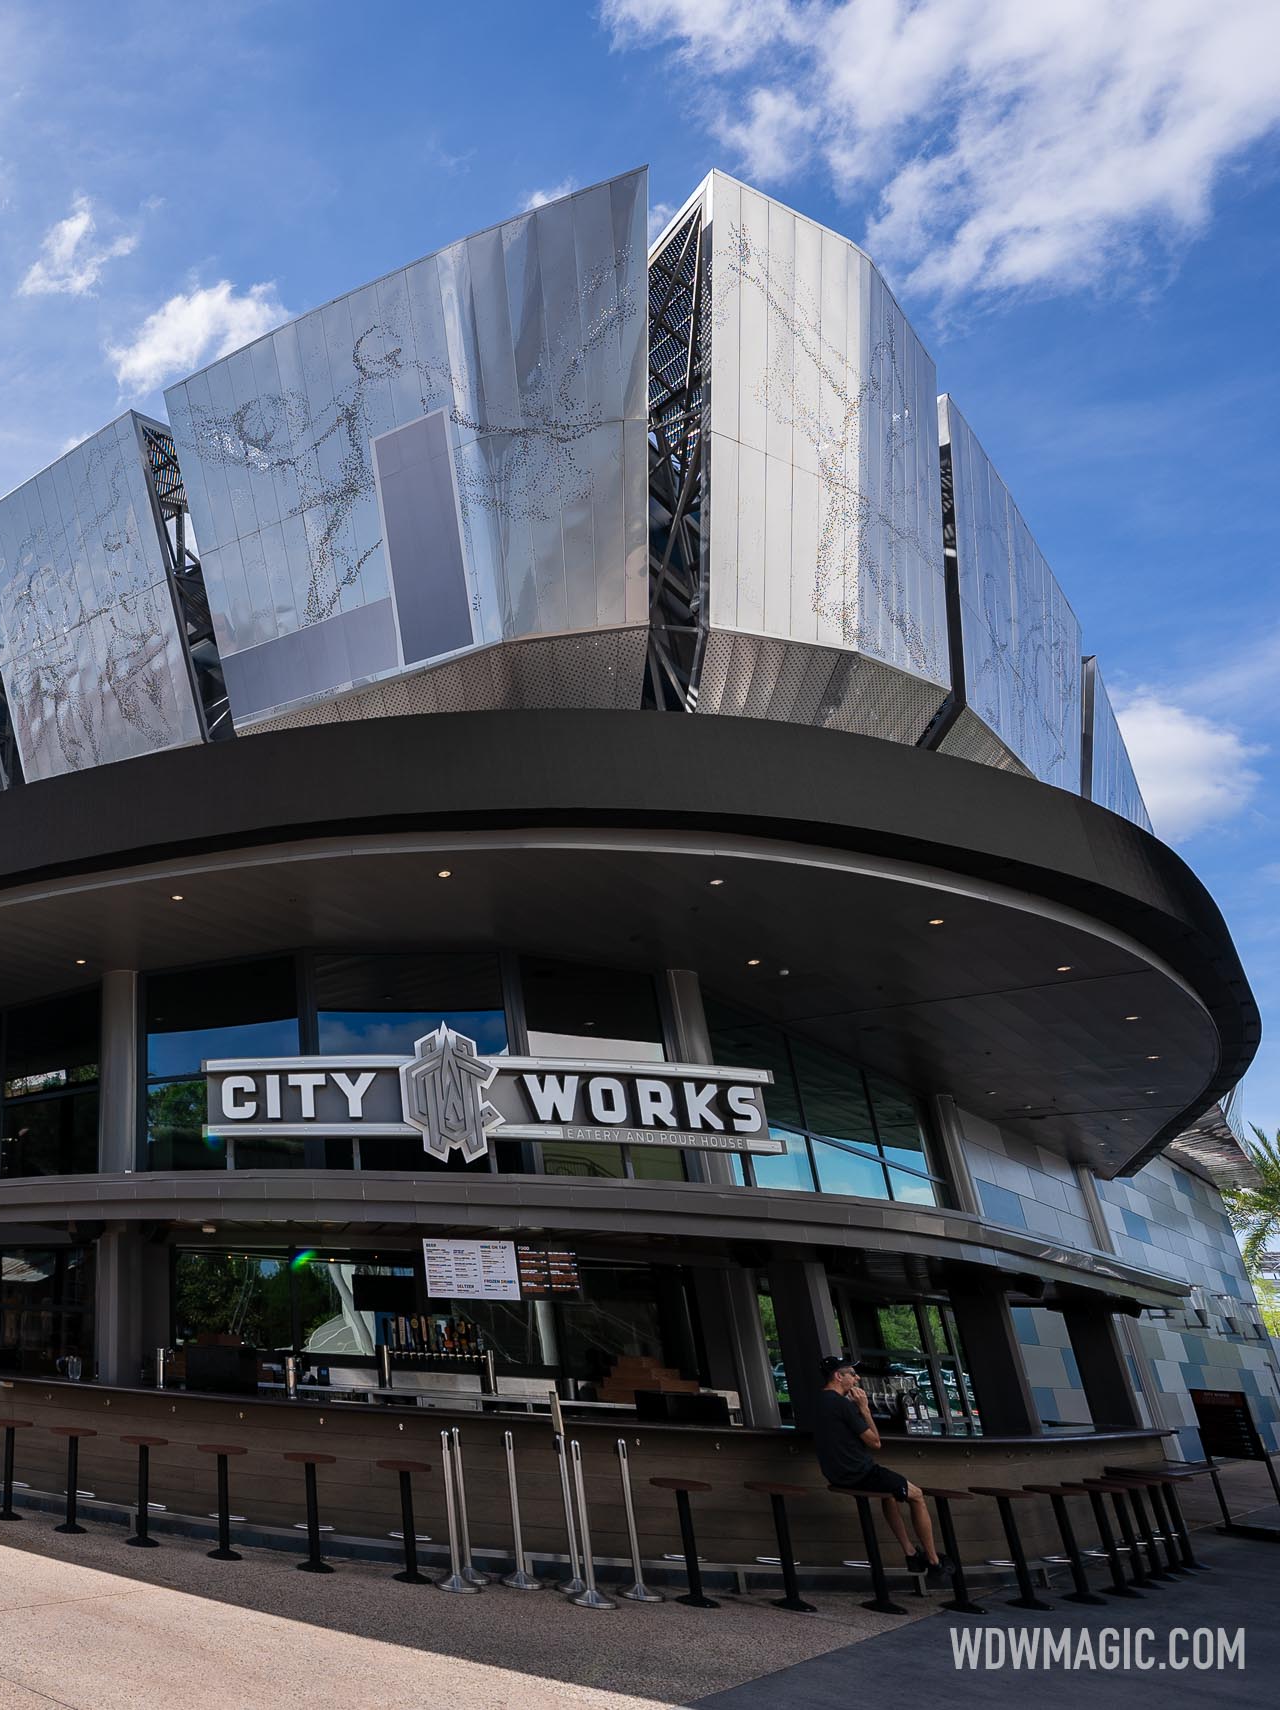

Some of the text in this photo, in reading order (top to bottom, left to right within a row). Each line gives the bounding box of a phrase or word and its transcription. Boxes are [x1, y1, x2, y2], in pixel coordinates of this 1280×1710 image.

[221, 1072, 762, 1132] CITY WORKS
[567, 1128, 744, 1149] EATERY AND POUR HOUSE
